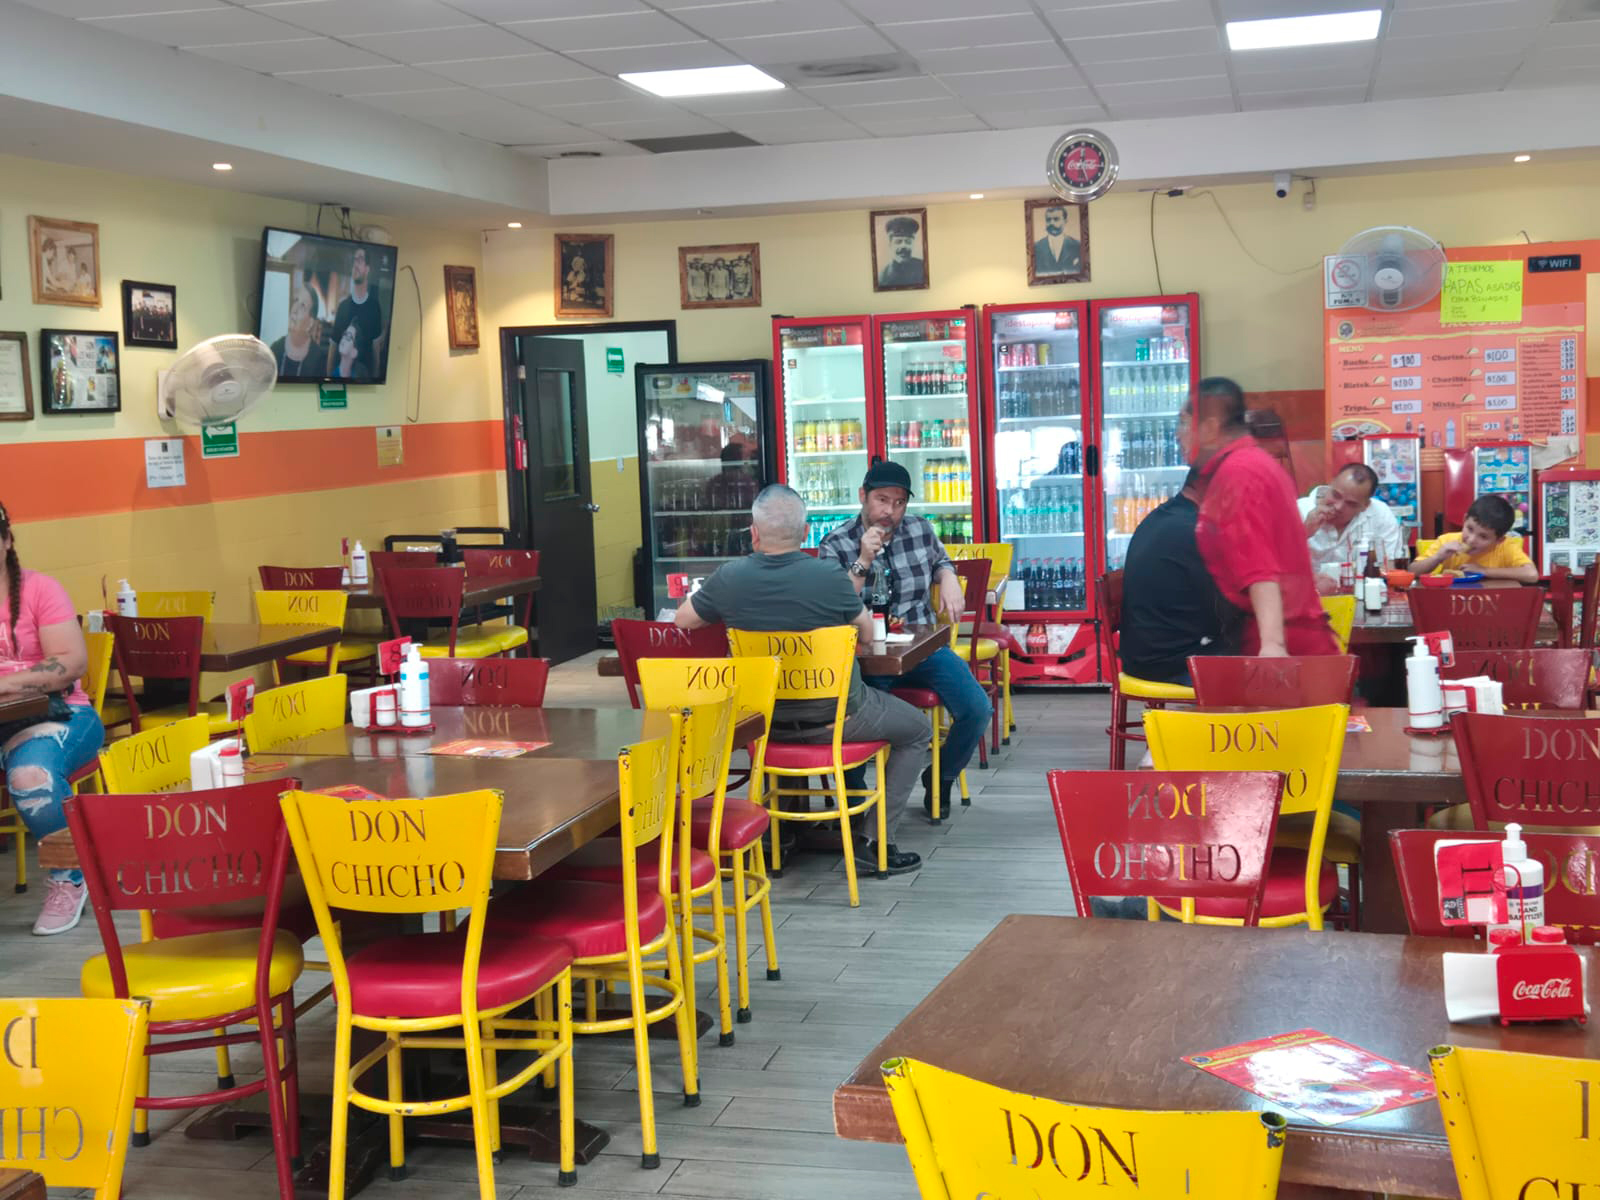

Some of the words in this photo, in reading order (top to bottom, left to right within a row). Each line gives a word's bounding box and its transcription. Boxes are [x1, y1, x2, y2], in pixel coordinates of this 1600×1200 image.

[1550, 258, 1572, 268] WIFI
[1443, 278, 1484, 294] PAPAS
[284, 571, 314, 586] DON
[1451, 594, 1500, 616] DON
[134, 622, 170, 640] DON
[650, 627, 694, 648] DON
[767, 636, 813, 656] DON
[778, 667, 835, 690] ICHO
[1209, 720, 1279, 753] DON
[1523, 727, 1600, 761] DON
[144, 800, 228, 839] DON
[349, 809, 428, 843] DON
[117, 848, 263, 896] CHICHO
[331, 860, 465, 898] CHICHO
[1513, 978, 1574, 1000] Coca-Cola
[1000, 1108, 1139, 1190] DON
